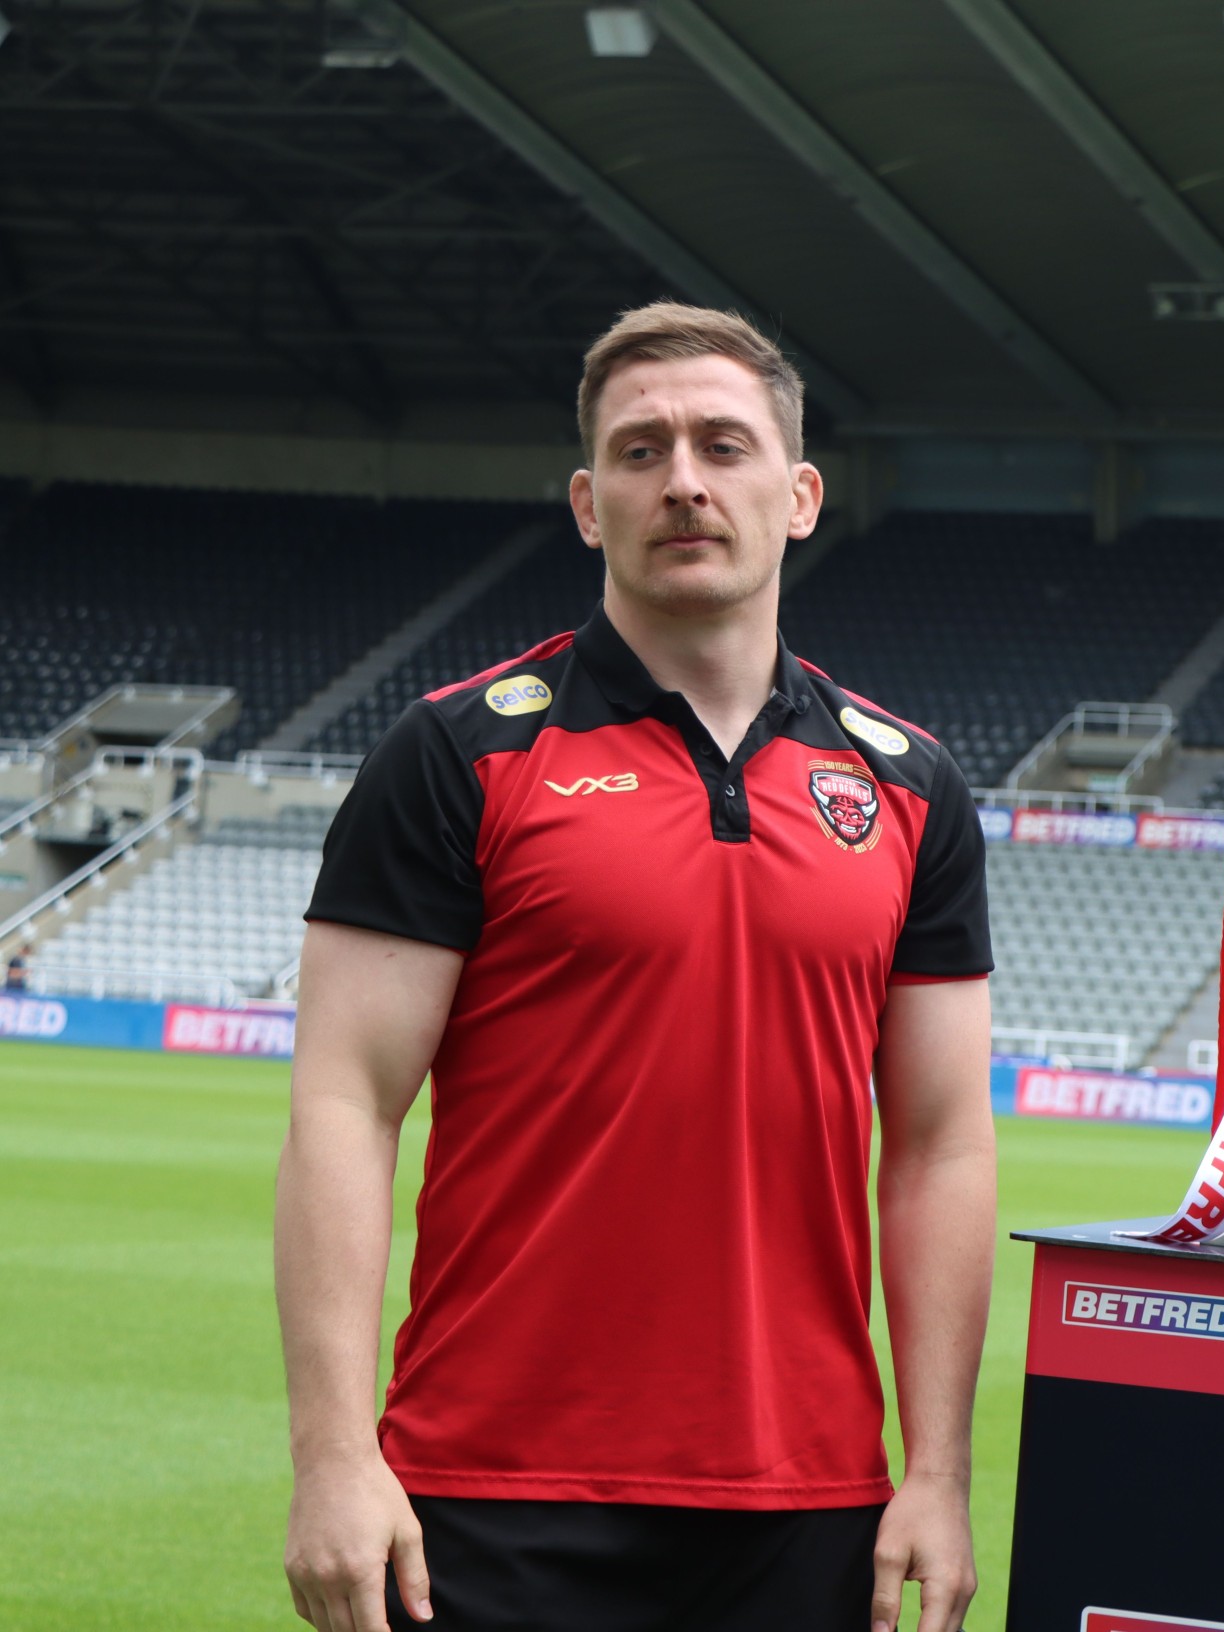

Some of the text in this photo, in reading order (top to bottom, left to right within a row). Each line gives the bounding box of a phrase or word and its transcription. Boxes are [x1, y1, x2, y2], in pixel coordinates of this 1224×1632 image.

[492, 684, 548, 709] selco
[544, 772, 639, 797] VX3
[820, 781, 869, 802] RED DEVILS
[1014, 815, 1135, 845] BETFRED
[170, 1008, 295, 1051] BETFR
[1024, 1072, 1212, 1124] BETFRED
